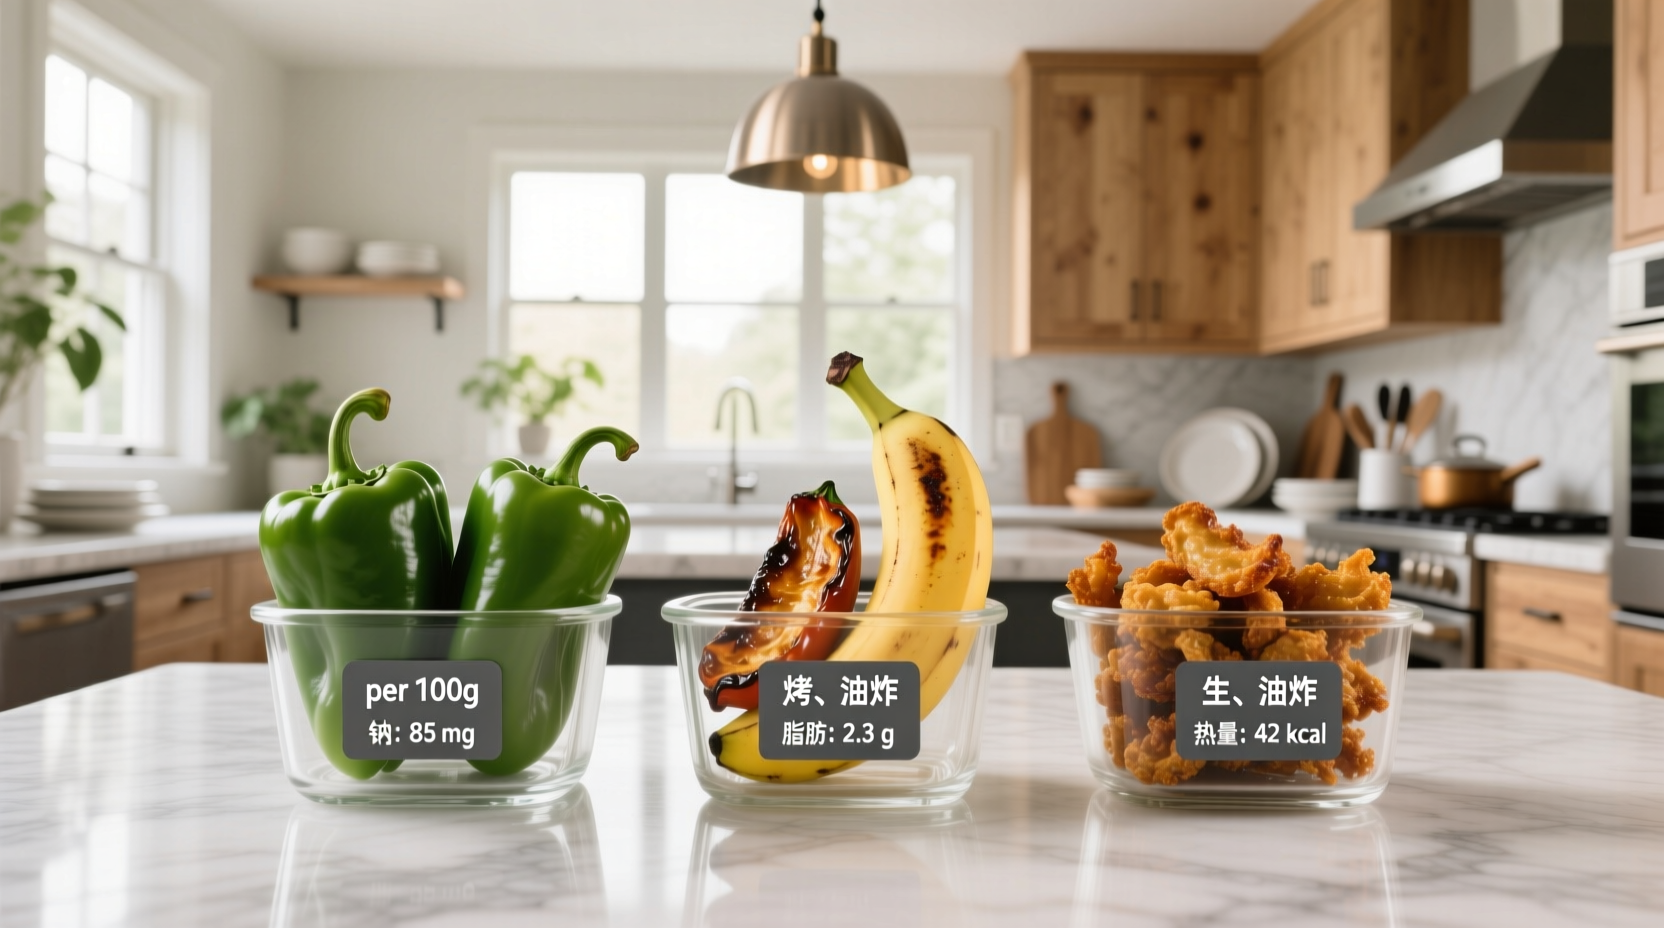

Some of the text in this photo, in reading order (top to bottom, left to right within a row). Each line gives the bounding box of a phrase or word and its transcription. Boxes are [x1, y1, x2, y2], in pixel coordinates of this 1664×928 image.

[366, 676, 479, 710] per 100g
[782, 674, 899, 707] 烤、油炸
[1202, 674, 1318, 707] 生、油炸
[409, 721, 436, 743] 85
[441, 727, 475, 750] mg
[842, 722, 875, 744] 2.3
[881, 727, 894, 750] g
[1253, 722, 1280, 744] 42
[1286, 721, 1327, 745] kcal
